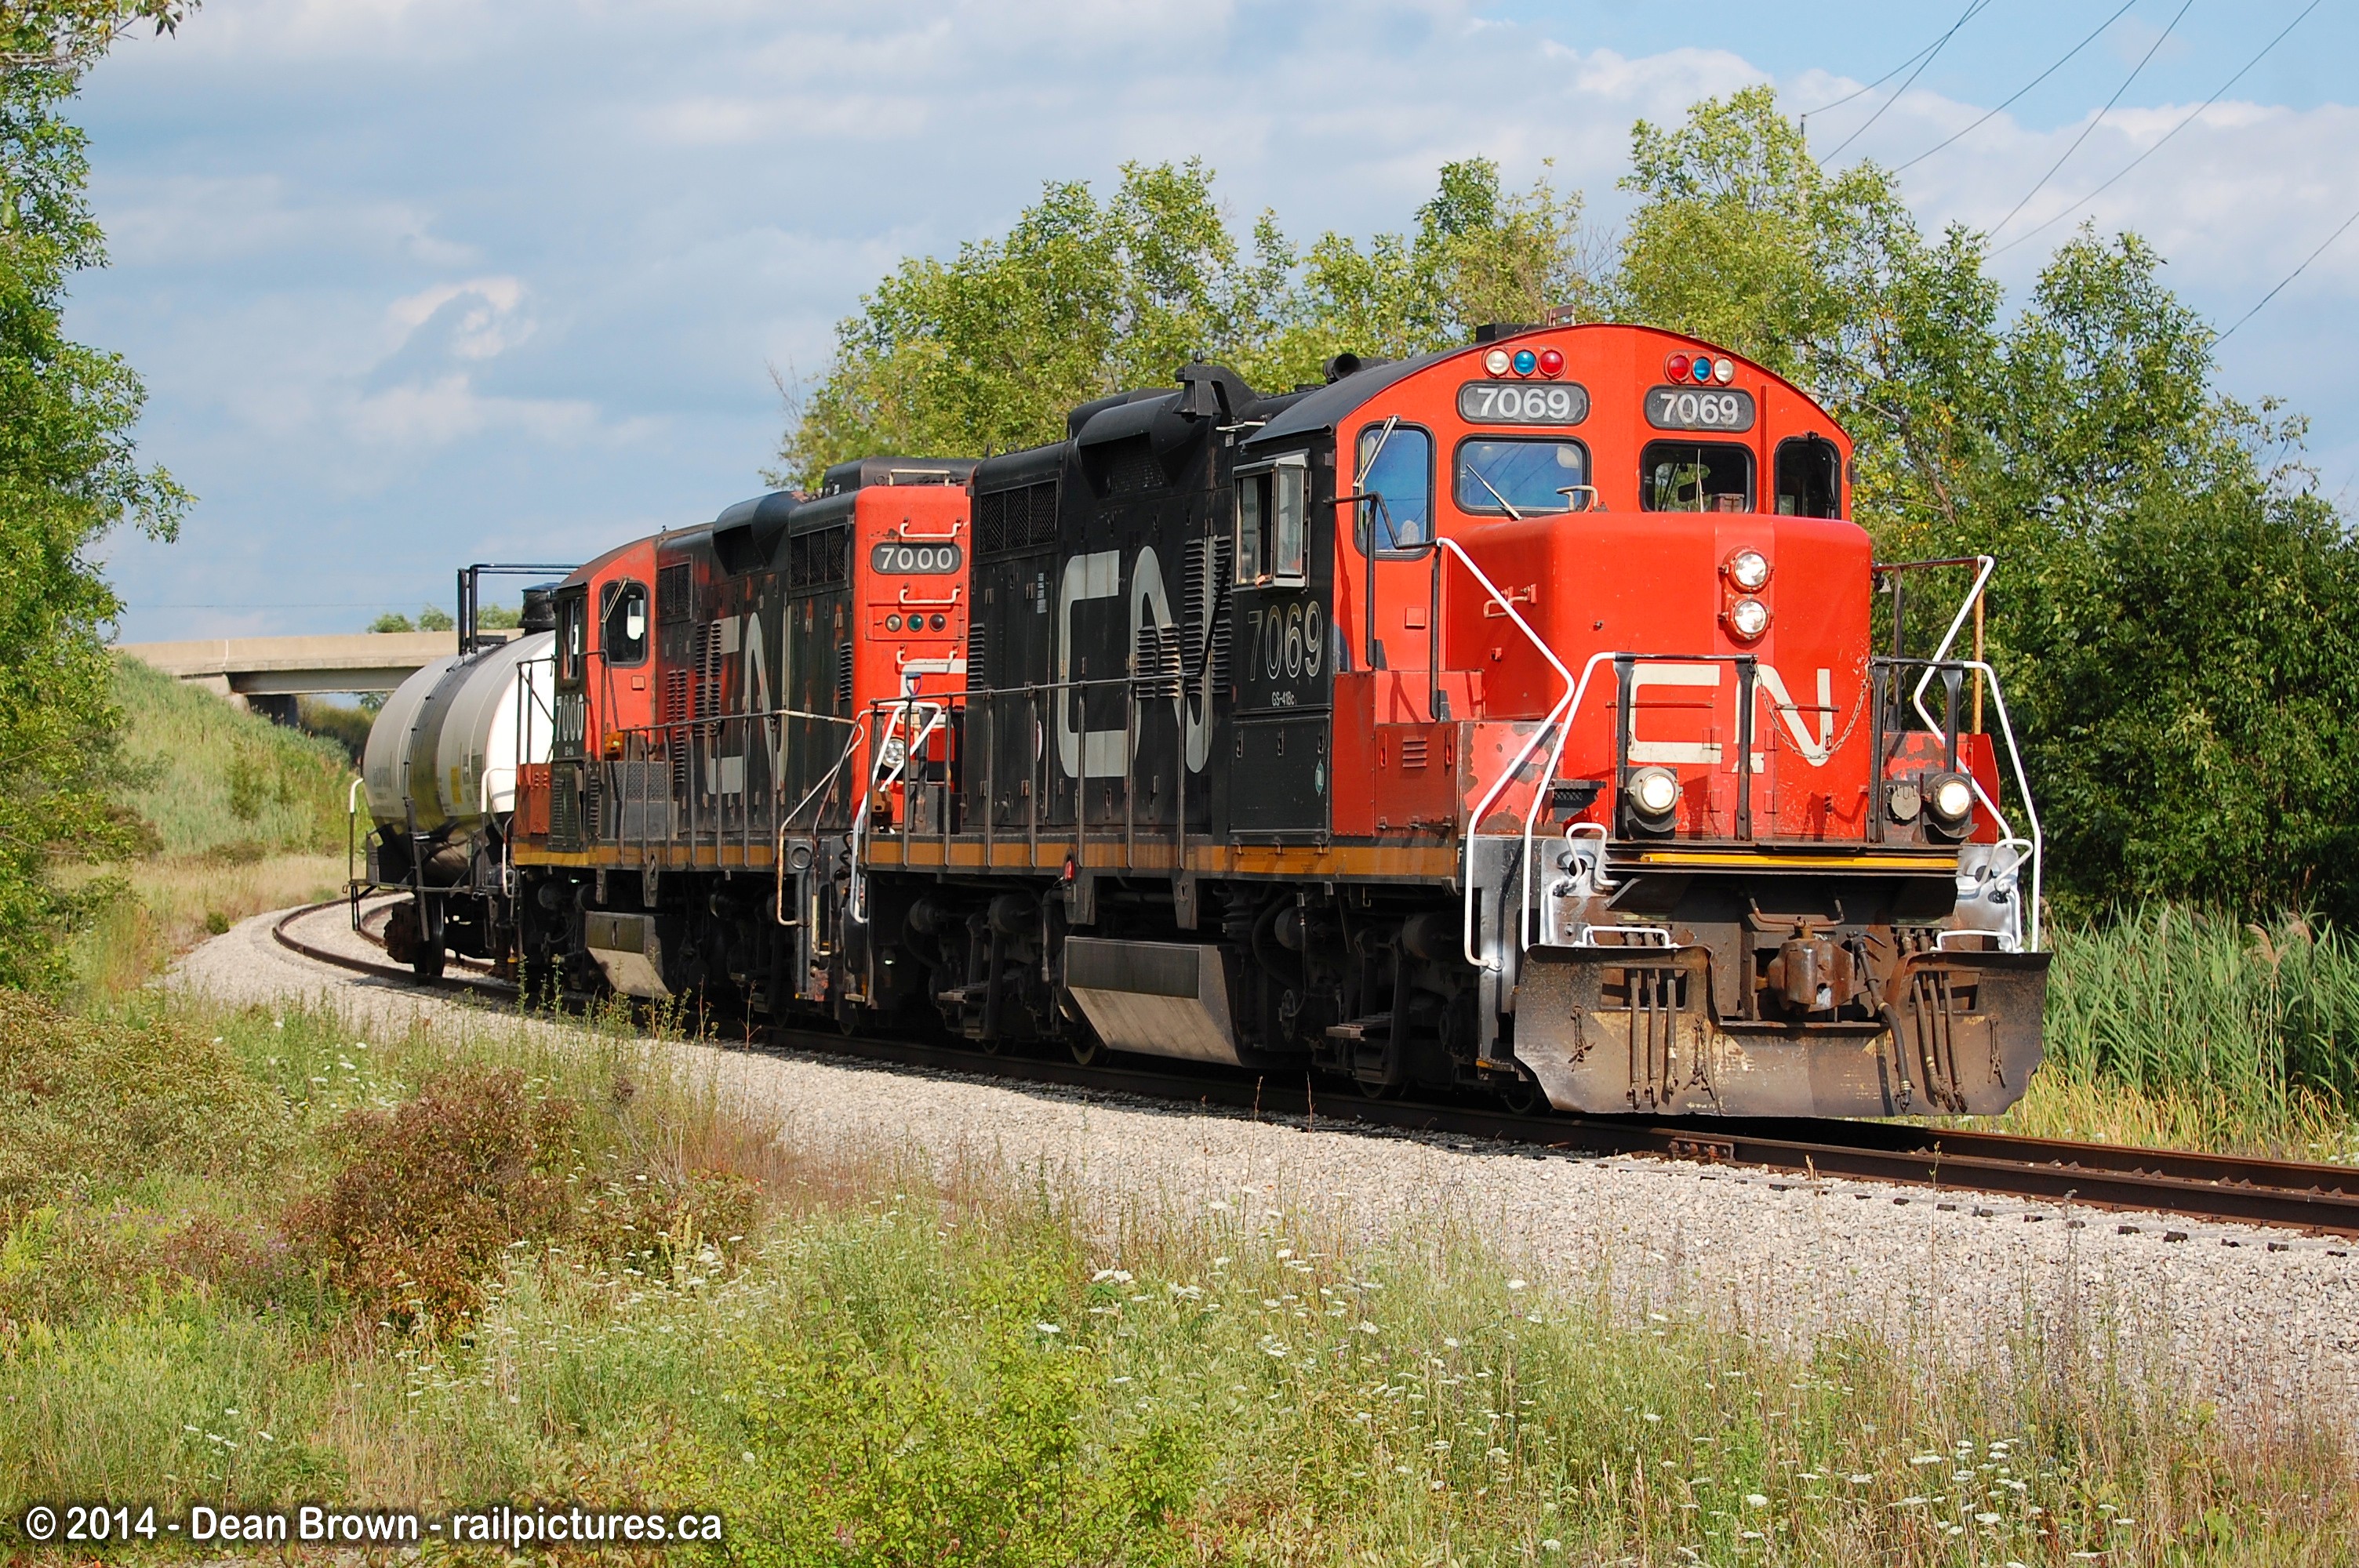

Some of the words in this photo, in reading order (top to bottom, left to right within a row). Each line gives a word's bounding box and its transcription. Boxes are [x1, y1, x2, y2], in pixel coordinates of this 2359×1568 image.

[1477, 387, 1570, 419] 7069
[1659, 393, 1739, 425] 7069
[881, 547, 954, 570] 7000
[1057, 535, 1216, 779] CN
[1248, 601, 1323, 681] 7069
[556, 693, 584, 742] 7000
[703, 610, 791, 795] CN
[1616, 662, 1834, 774] CN
